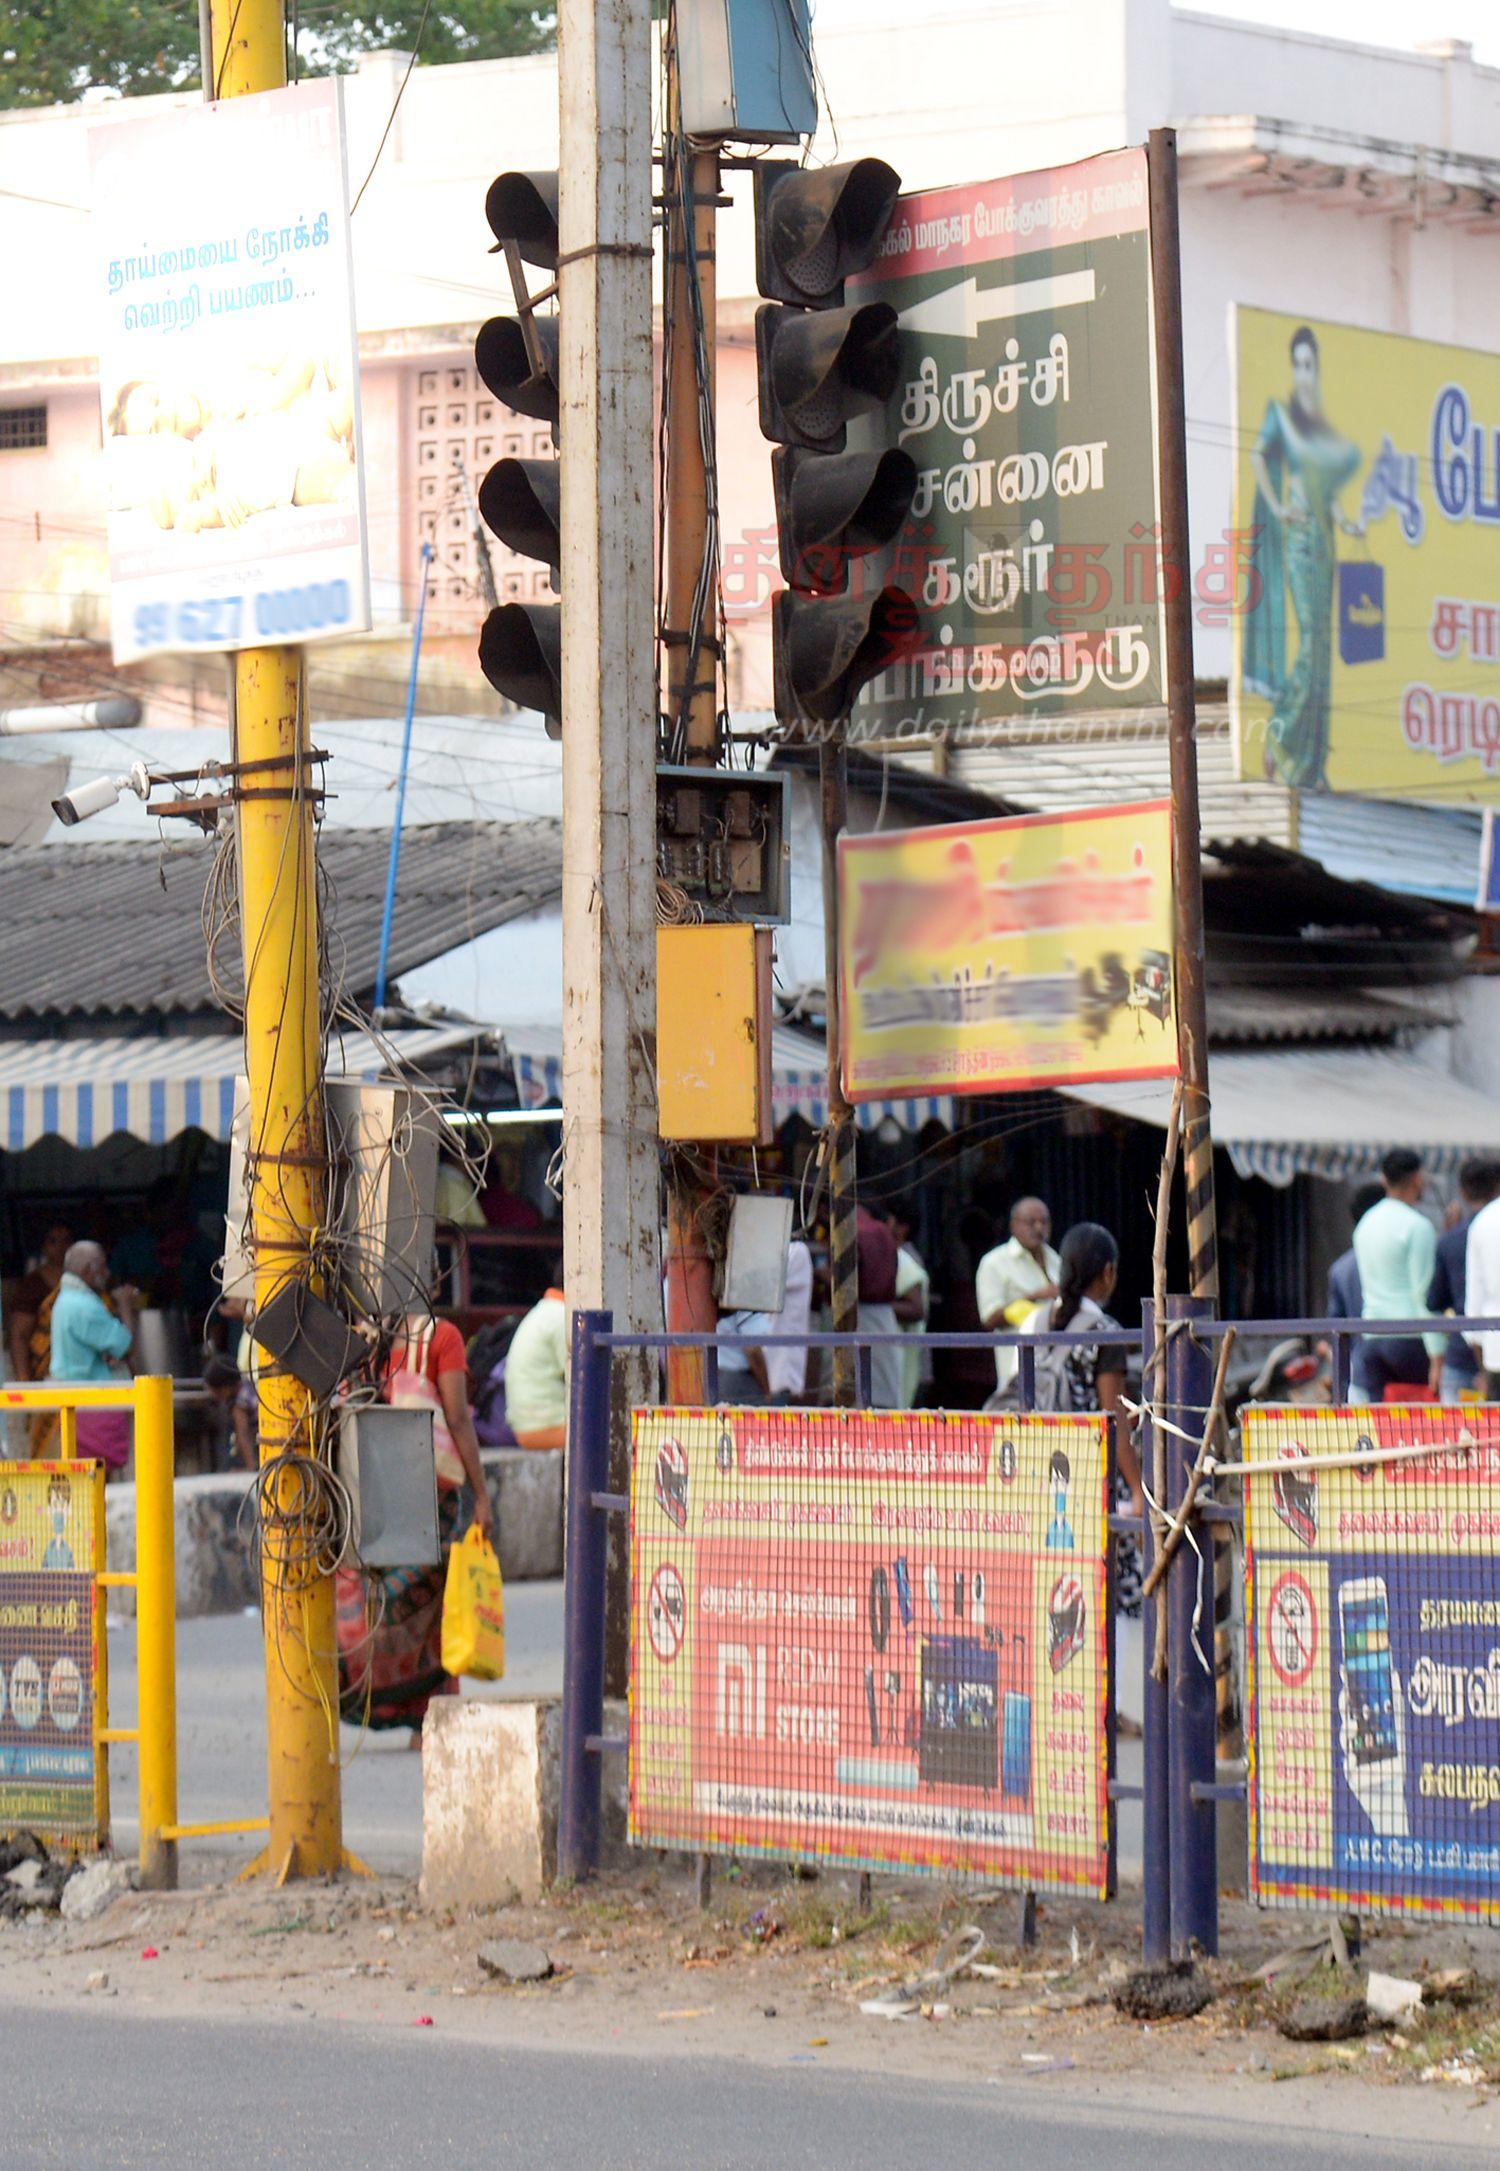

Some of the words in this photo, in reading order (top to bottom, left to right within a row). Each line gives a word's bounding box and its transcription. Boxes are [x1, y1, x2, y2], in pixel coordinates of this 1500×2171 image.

[108, 240, 238, 296] தாய்மையை
[246, 211, 329, 267] நோக்கி
[914, 213, 970, 257] மாநகர
[974, 186, 1088, 237] போக்குவரத்து
[124, 283, 201, 334] வெற்றி
[898, 332, 1070, 446] திருச்சி
[910, 437, 1108, 519] சன்னை
[922, 518, 1054, 615] கரூர்
[857, 624, 1150, 704] பங்களூரு
